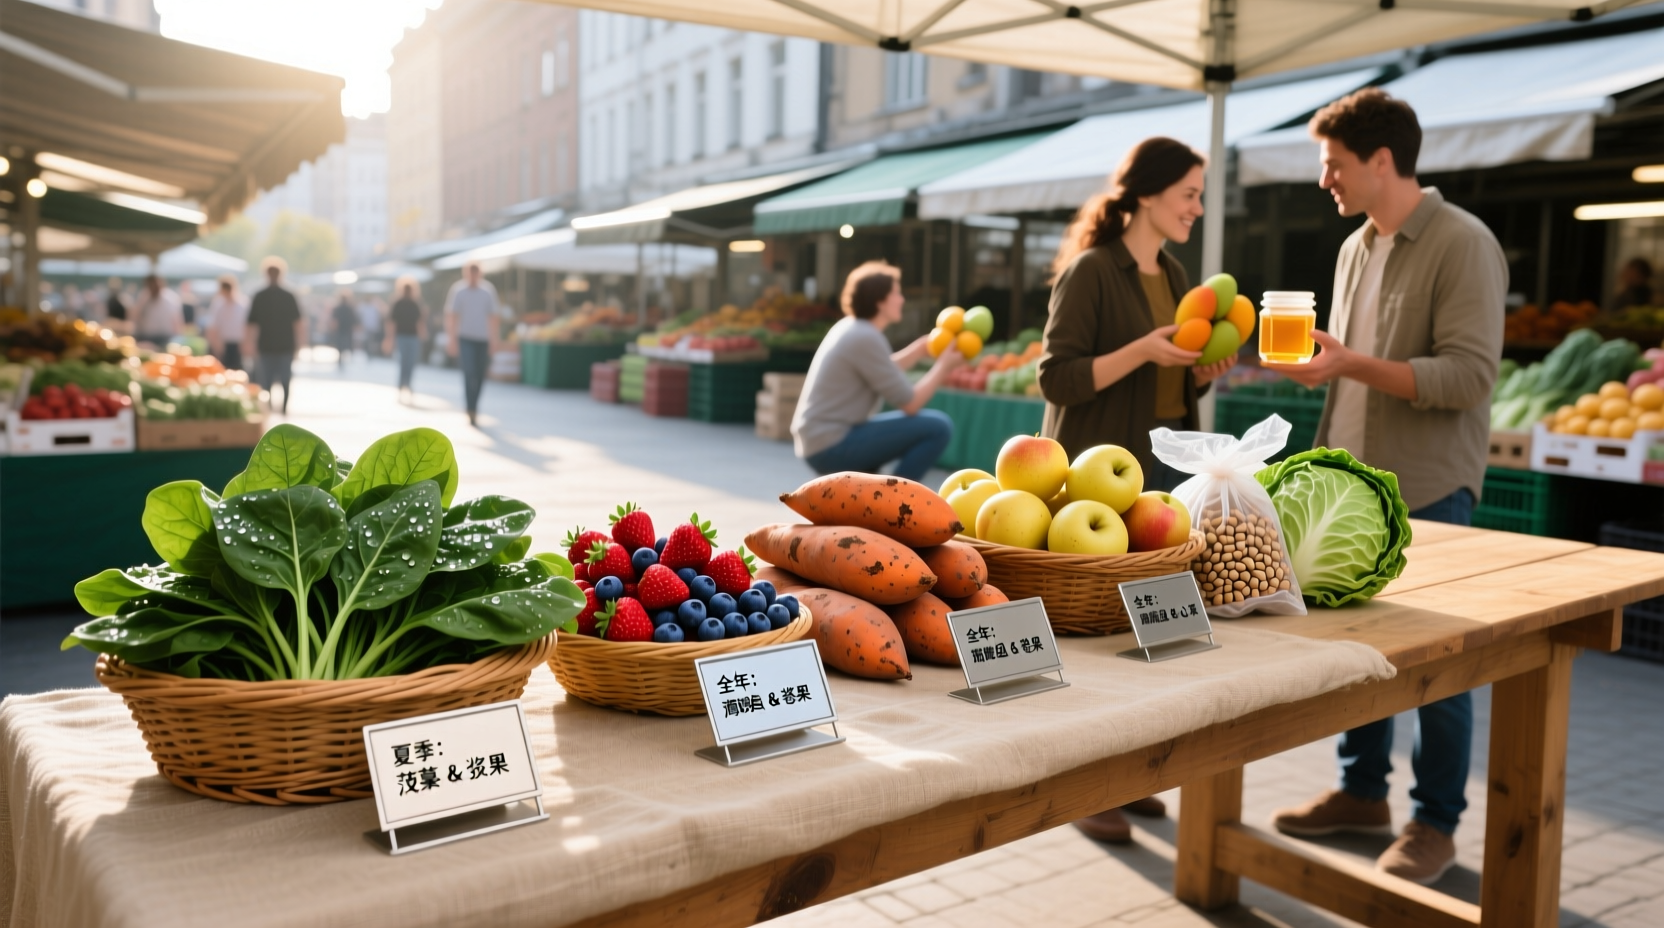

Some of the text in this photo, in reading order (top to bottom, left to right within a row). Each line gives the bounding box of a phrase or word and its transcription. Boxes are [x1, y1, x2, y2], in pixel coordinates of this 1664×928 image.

[717, 671, 757, 694] 全年:
[768, 692, 781, 707] &
[391, 739, 443, 767] 夏季:
[447, 764, 463, 782] &
